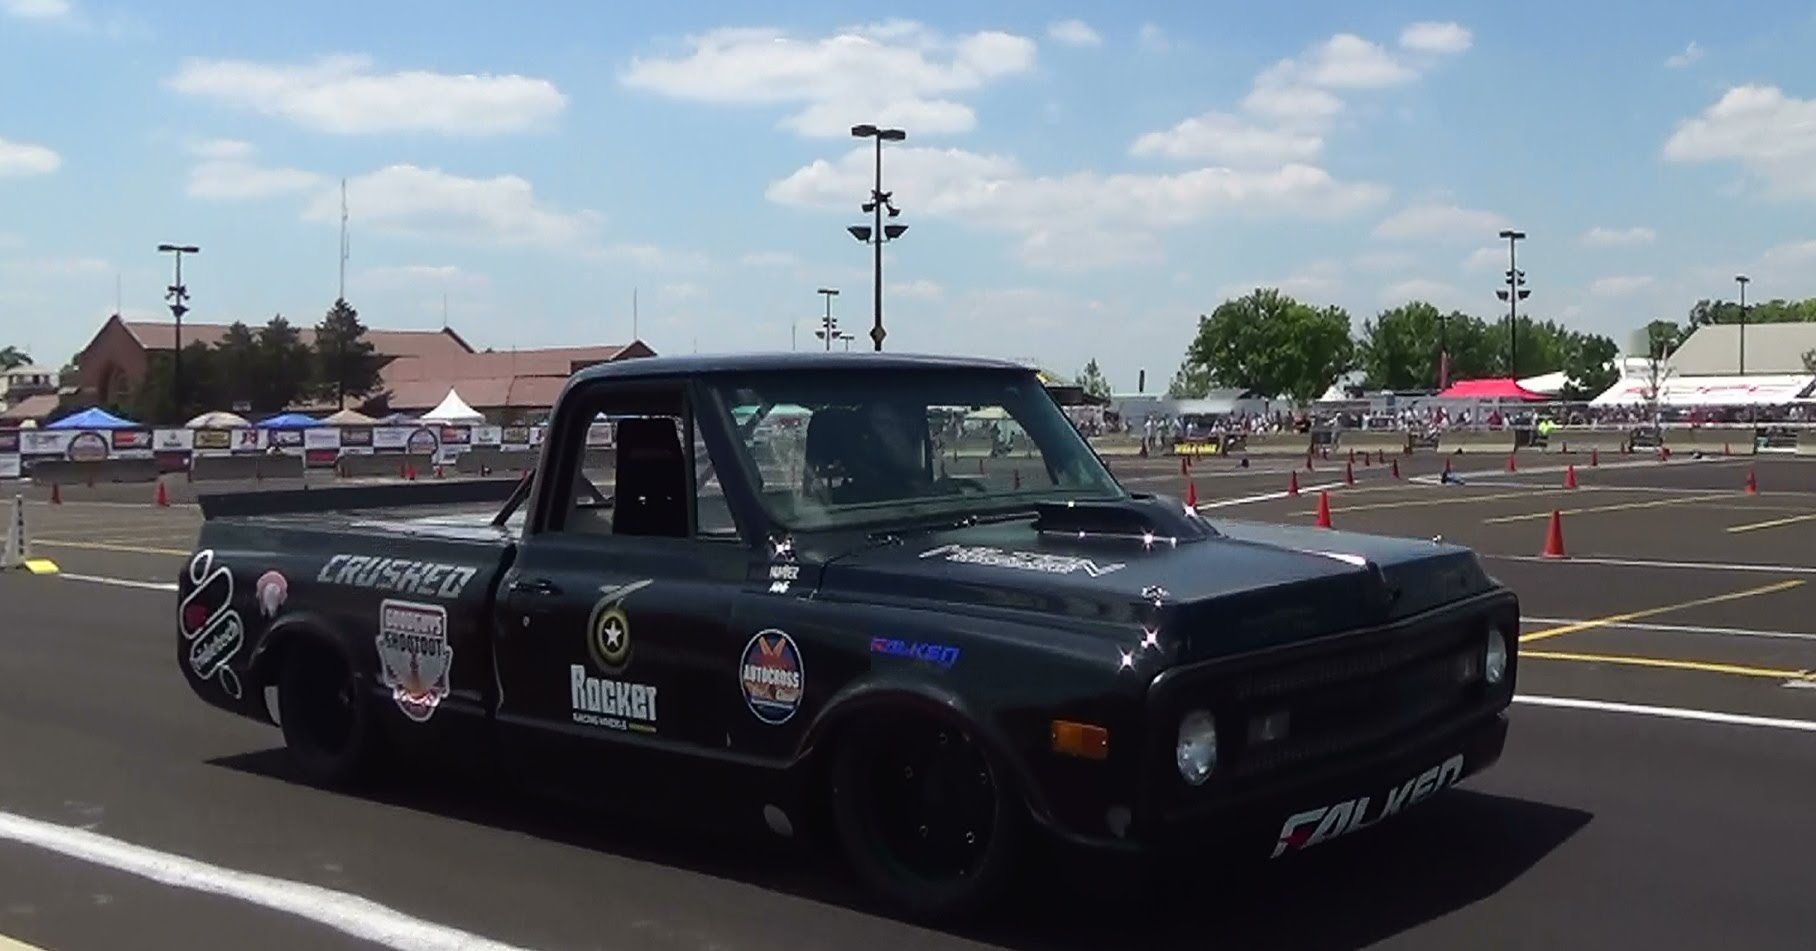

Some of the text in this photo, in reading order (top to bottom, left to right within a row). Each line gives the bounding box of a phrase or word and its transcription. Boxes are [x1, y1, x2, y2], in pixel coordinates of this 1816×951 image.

[317, 554, 477, 598] CRUSHED
[384, 631, 442, 657] SHOOTOUT
[743, 664, 800, 688] AUTOCROSS
[1269, 753, 1465, 859] FALKEN
